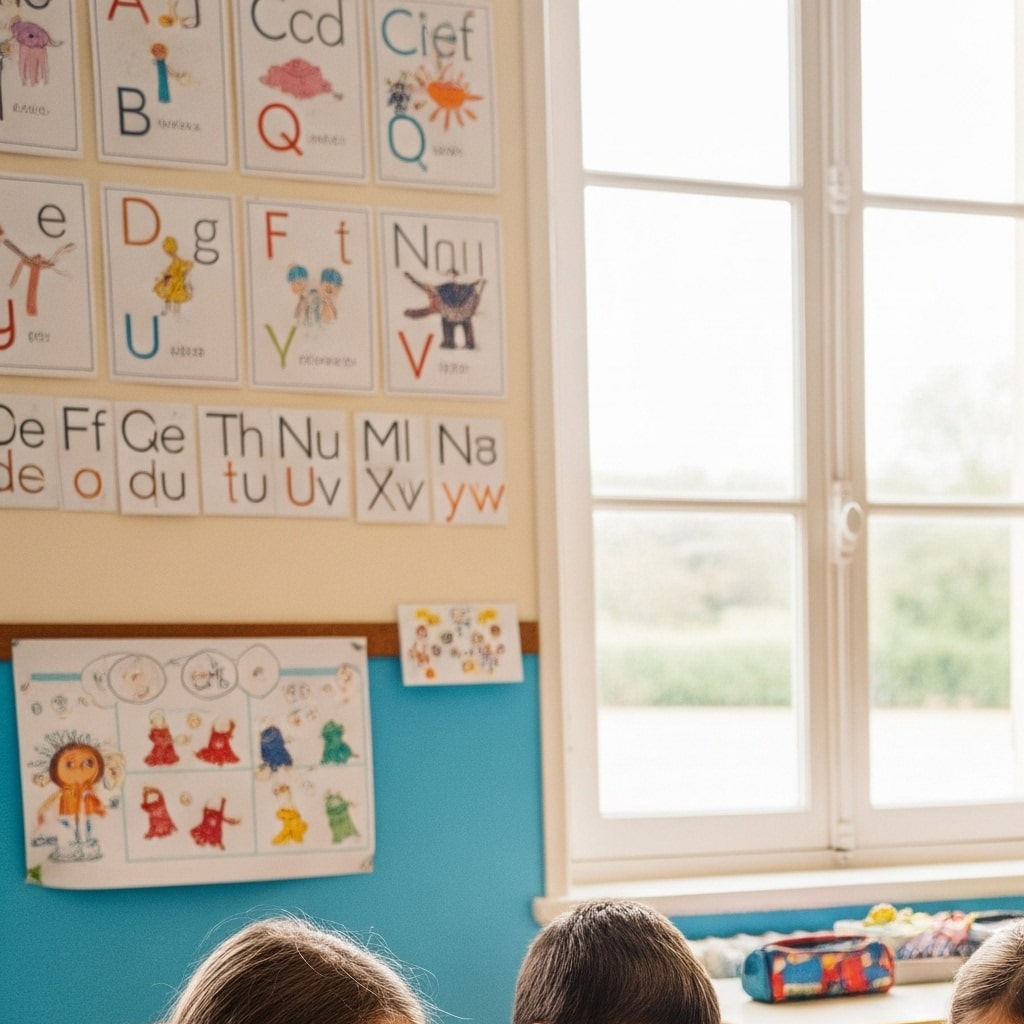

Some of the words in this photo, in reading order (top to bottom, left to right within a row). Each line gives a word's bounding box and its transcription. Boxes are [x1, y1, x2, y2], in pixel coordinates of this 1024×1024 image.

[117, 86, 151, 137] B
[257, 103, 304, 156] Q
[388, 113, 428, 172] Q
[37, 204, 66, 238] e
[122, 197, 161, 246] D
[194, 219, 219, 265] g
[265, 211, 288, 260] F
[335, 220, 352, 265] t
[125, 313, 160, 360] U
[265, 323, 297, 369] Y
[398, 331, 434, 379] V
[63, 406, 107, 451] Ff
[206, 412, 264, 458] Th
[279, 416, 339, 460] Nu
[223, 460, 267, 503] tu
